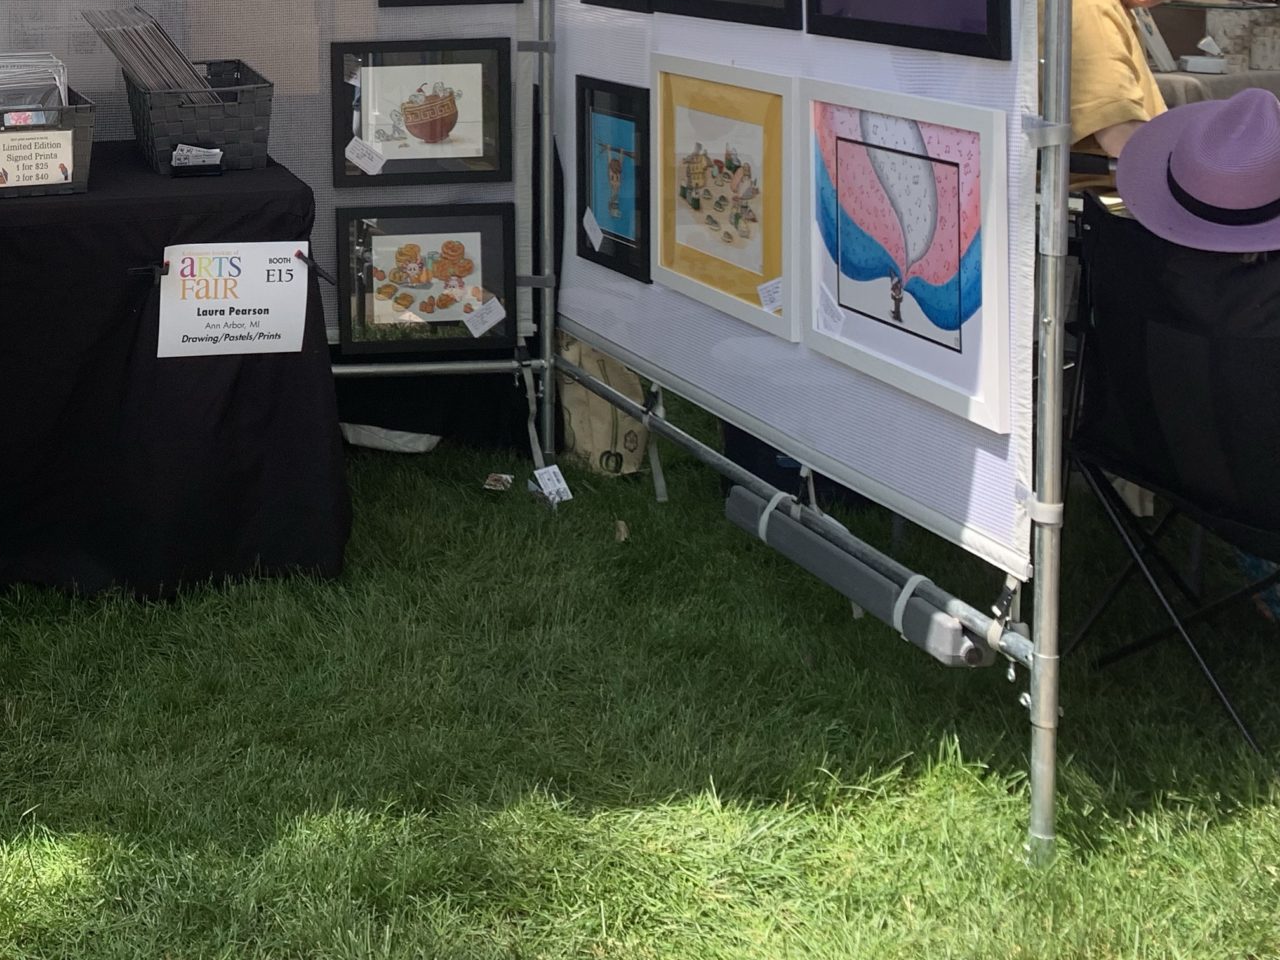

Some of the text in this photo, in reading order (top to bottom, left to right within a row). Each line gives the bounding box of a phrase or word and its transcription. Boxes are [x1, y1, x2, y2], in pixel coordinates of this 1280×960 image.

[3, 143, 32, 151] Limited
[6, 154, 32, 162] Signed
[266, 269, 294, 282] E15
[197, 306, 270, 316] Laura Pearson
[224, 322, 246, 330] Arbor,
[182, 332, 282, 344] Drawing/Pastels/Prints
